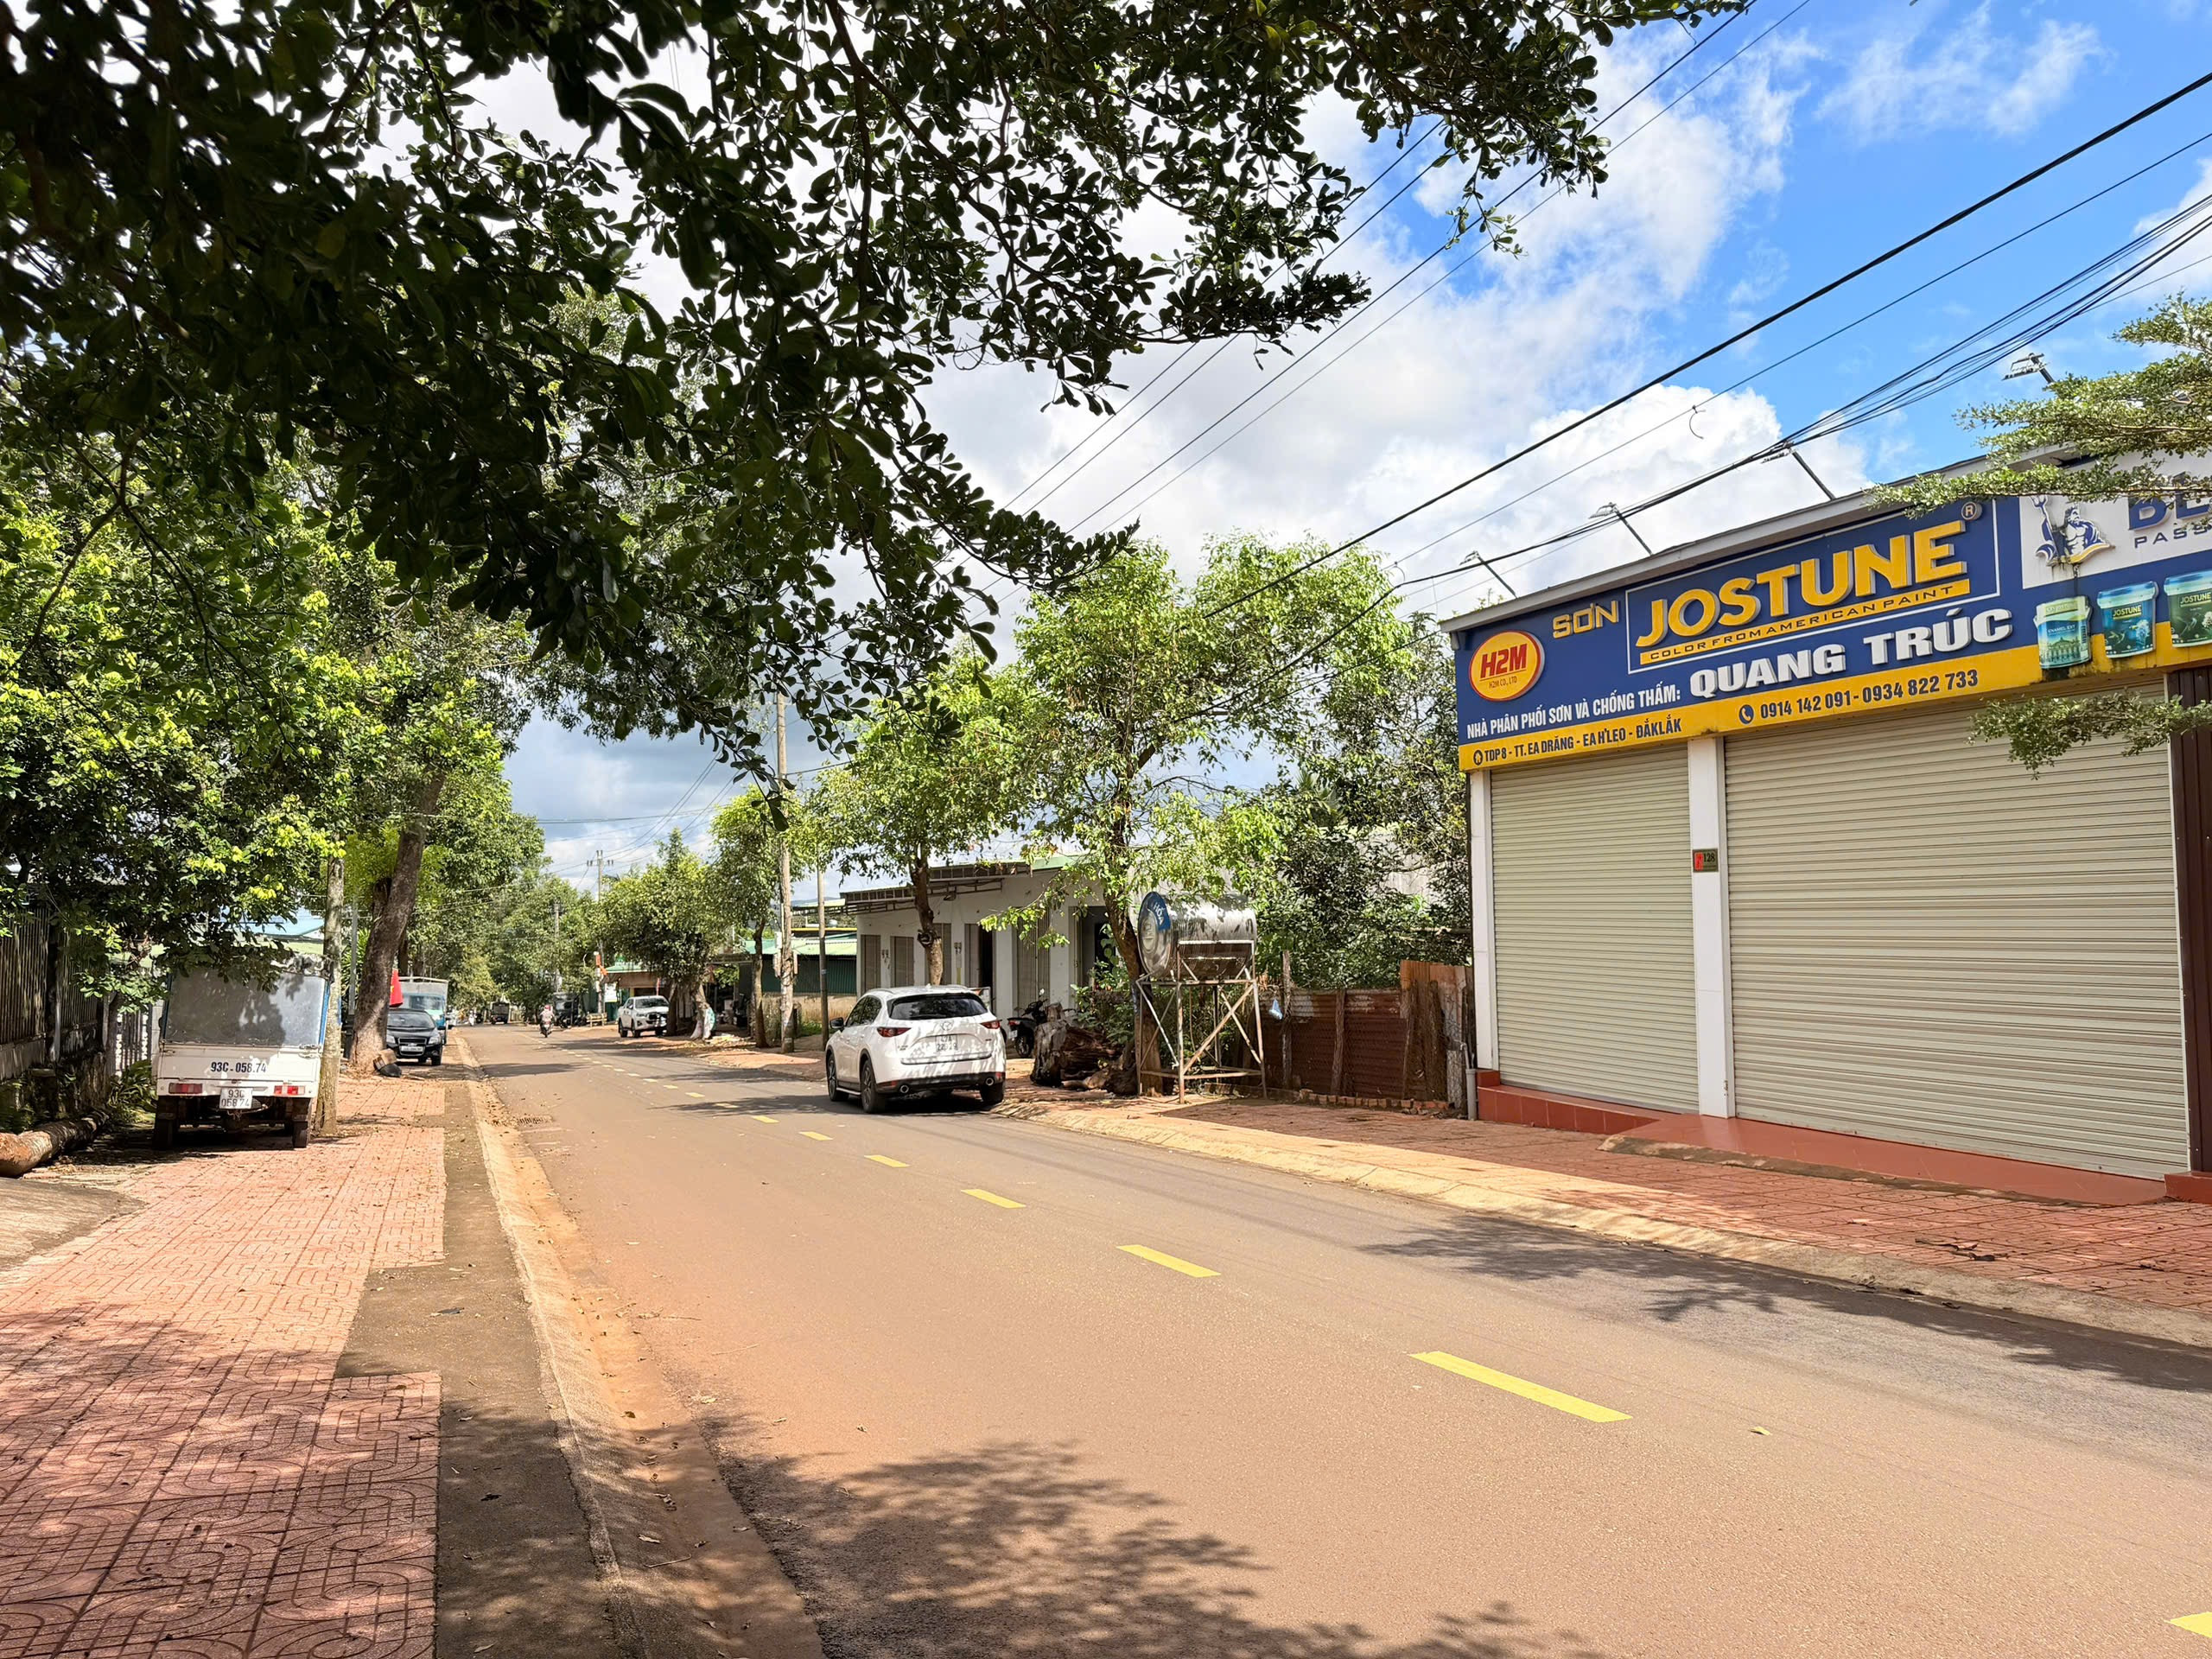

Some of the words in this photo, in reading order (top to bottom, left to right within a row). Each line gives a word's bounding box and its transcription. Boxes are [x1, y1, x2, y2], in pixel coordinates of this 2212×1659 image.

[1636, 520, 1967, 647] JOSTUNE
[2180, 592, 2211, 604] JOSTUNE
[1553, 601, 1618, 639] SƠN
[1650, 641, 1707, 659] COLOR
[1712, 629, 1761, 646] FROM
[1766, 604, 1875, 634] AMERICAN
[1883, 586, 1954, 608] PAINT
[2113, 605, 2142, 617] JOSTUNE
[1480, 644, 1528, 678] H2M
[1690, 644, 1846, 698] QUANG
[1863, 607, 2012, 665] TRÚC
[1467, 718, 1488, 739] NHÀ
[1491, 709, 1519, 734] PHÂN
[1521, 704, 1546, 729] PHỐI
[1548, 704, 1572, 723] SƠN
[1575, 697, 1590, 719] VÀ
[1593, 689, 1635, 715] CHỐNG
[1638, 681, 1681, 708] THẤM:
[1760, 701, 1792, 719] 0914
[1797, 695, 1821, 714] 142
[1862, 683, 1904, 703] 0934
[1908, 676, 1940, 696] 822
[1945, 669, 1978, 690] 733
[1541, 735, 1574, 753] DRĂNG
[1637, 714, 1681, 739] ĐẮKLẮK
[211, 1062, 229, 1072] 93C
[235, 1062, 266, 1072] 058.74
